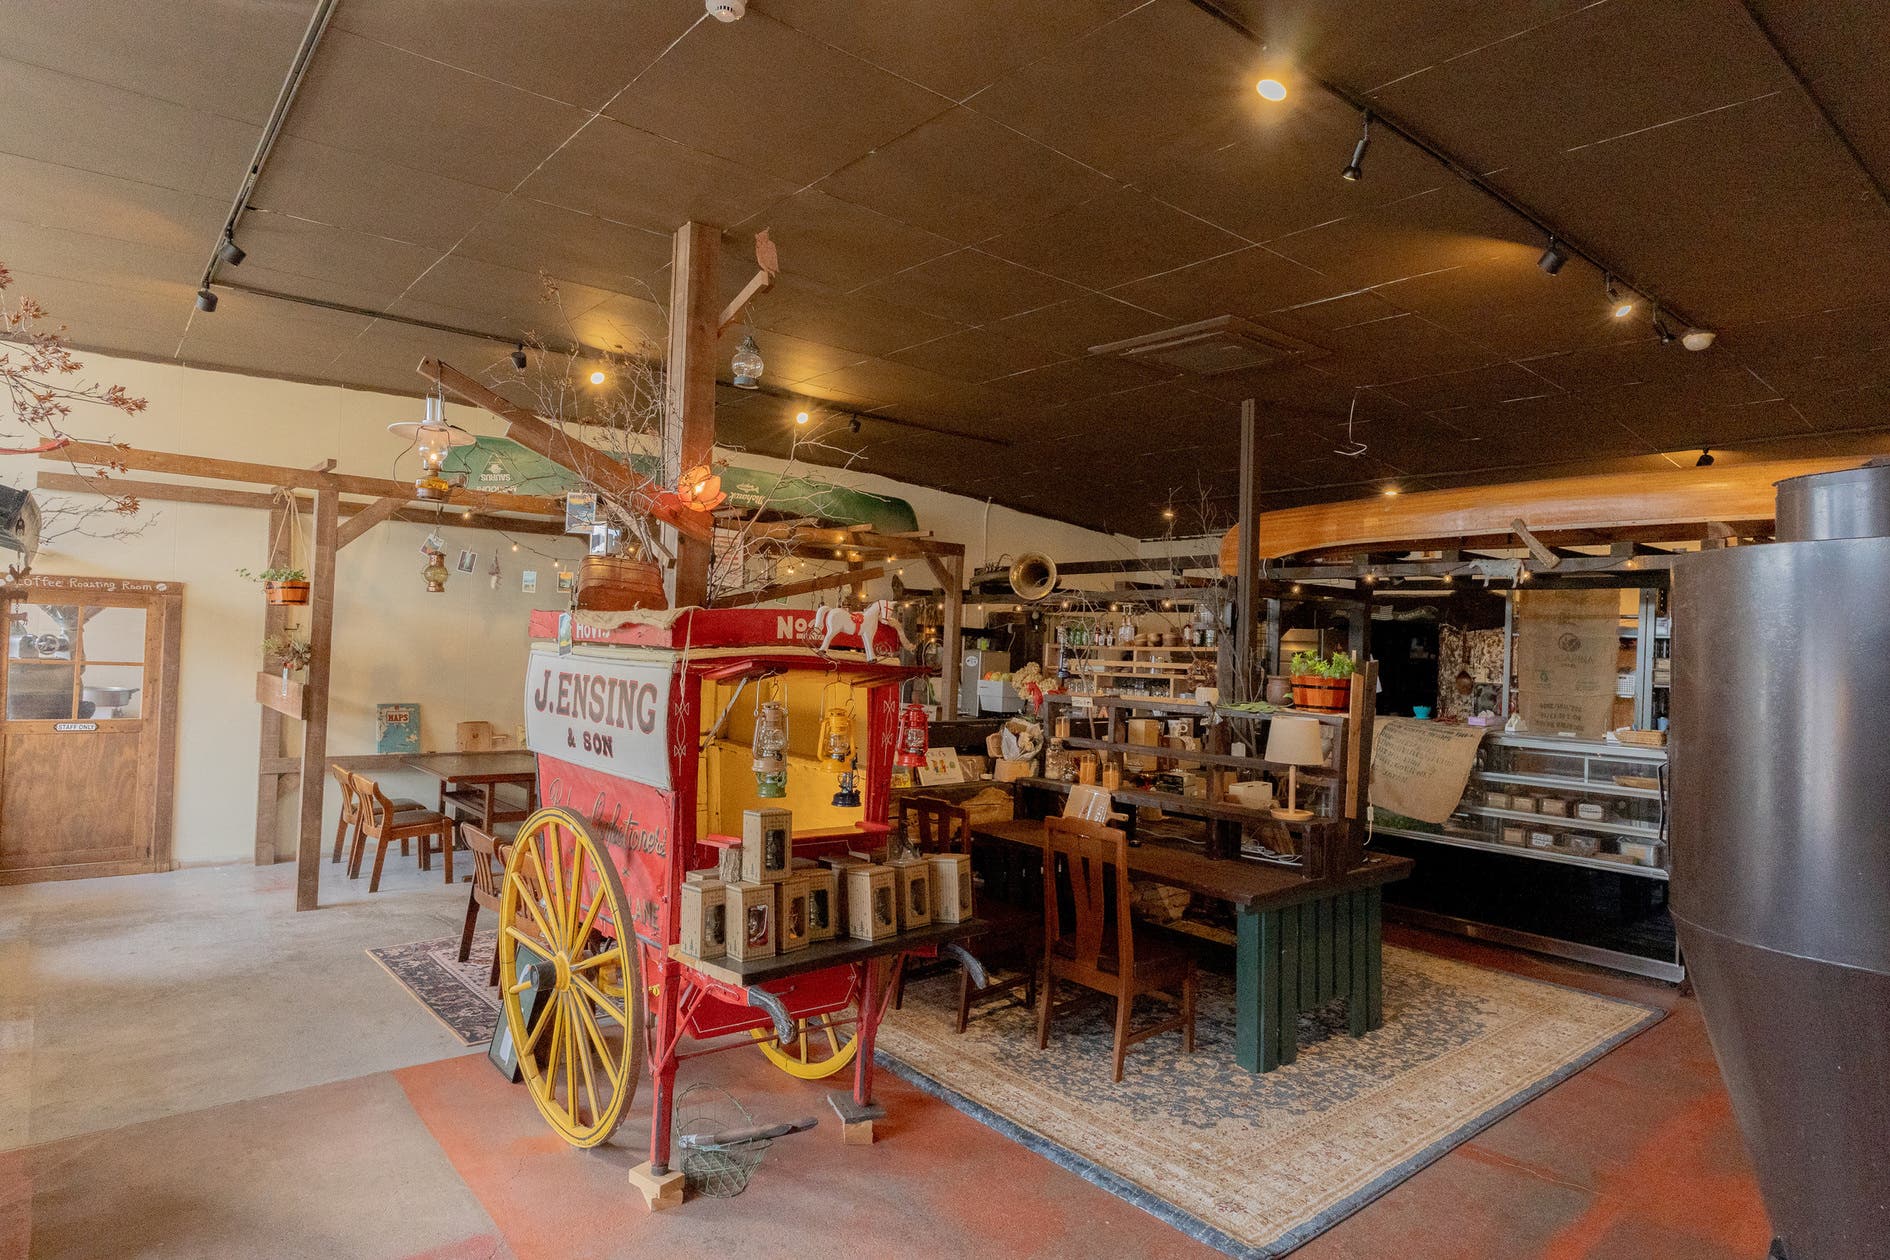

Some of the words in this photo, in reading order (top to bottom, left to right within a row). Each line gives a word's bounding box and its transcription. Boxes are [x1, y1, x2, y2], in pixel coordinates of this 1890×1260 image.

[480, 473, 511, 482] SAURUS
[69, 577, 117, 592] Roasting
[122, 581, 153, 591] Room
[387, 713, 409, 722] MAPS
[567, 727, 577, 748] &
[582, 730, 614, 758] SON
